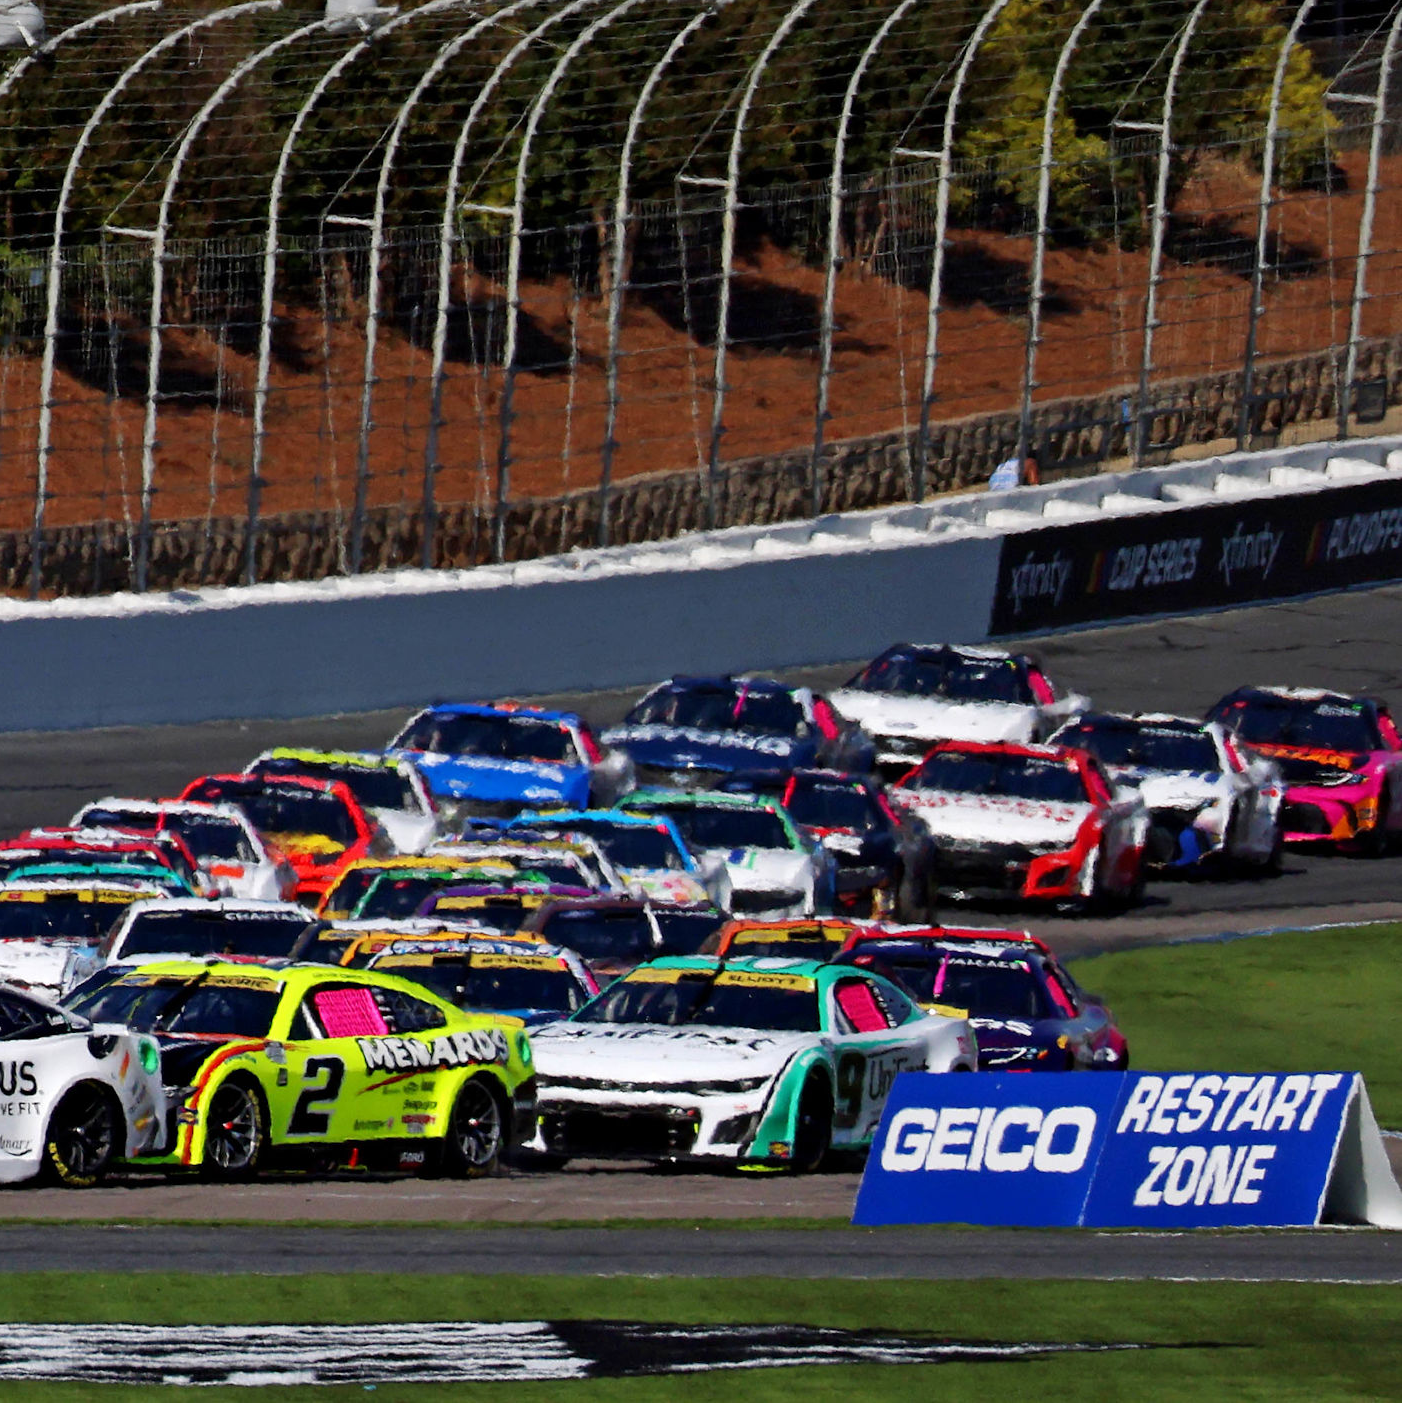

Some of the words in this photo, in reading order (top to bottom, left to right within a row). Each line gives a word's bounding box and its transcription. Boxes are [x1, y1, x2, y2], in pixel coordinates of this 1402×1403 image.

[1011, 550, 1073, 614] xfinity
[1107, 545, 1148, 591] CUP
[1142, 537, 1202, 586] SERIES
[1218, 521, 1284, 586] xfinity
[358, 1029, 508, 1074] MENARDS
[17, 1101, 42, 1116] FIT
[287, 1054, 346, 1137] 2
[837, 1051, 866, 1125] 9
[1115, 1072, 1344, 1135] RESTART
[880, 1105, 1097, 1174] GEICO
[1133, 1144, 1277, 1208] ZONE
